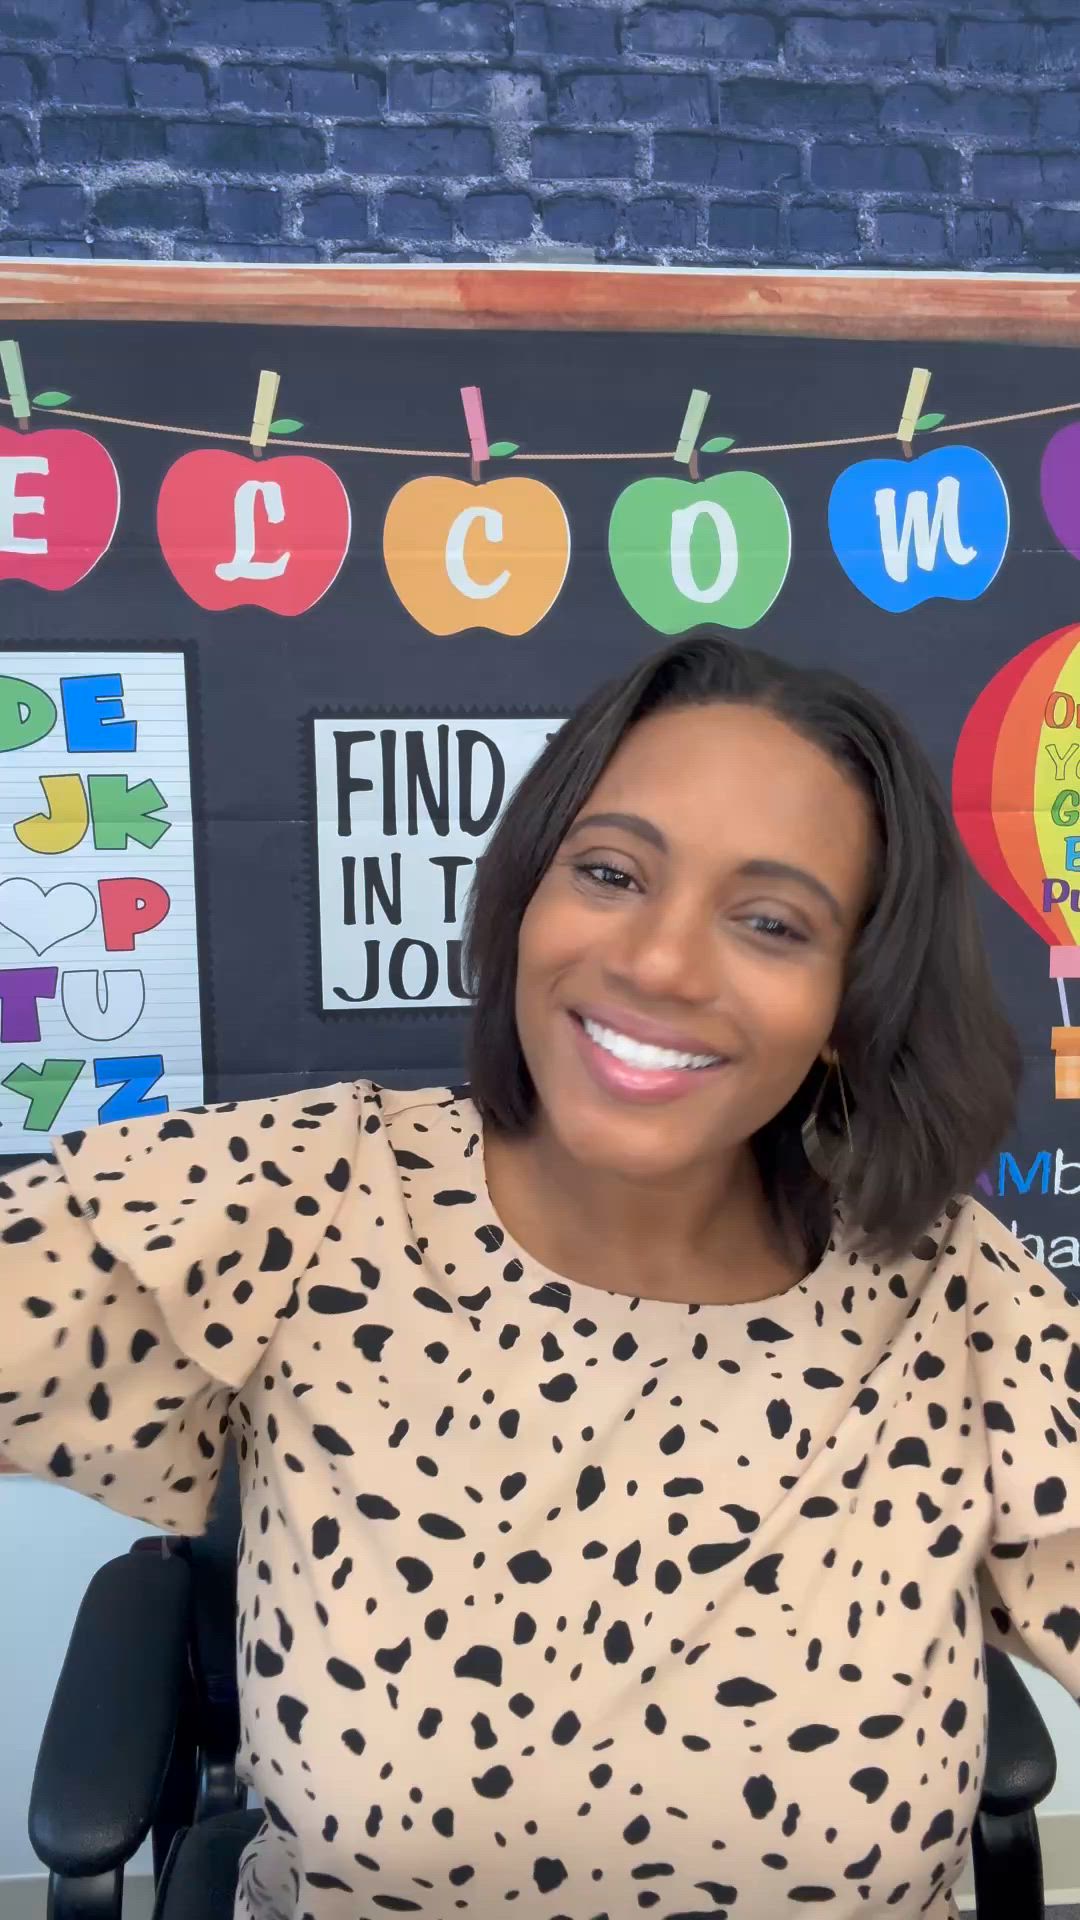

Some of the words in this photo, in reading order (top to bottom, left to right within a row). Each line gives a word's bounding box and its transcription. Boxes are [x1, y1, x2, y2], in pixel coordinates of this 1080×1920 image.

[333, 724, 505, 836] FIND
[342, 853, 402, 925] IN
[429, 856, 480, 923] T
